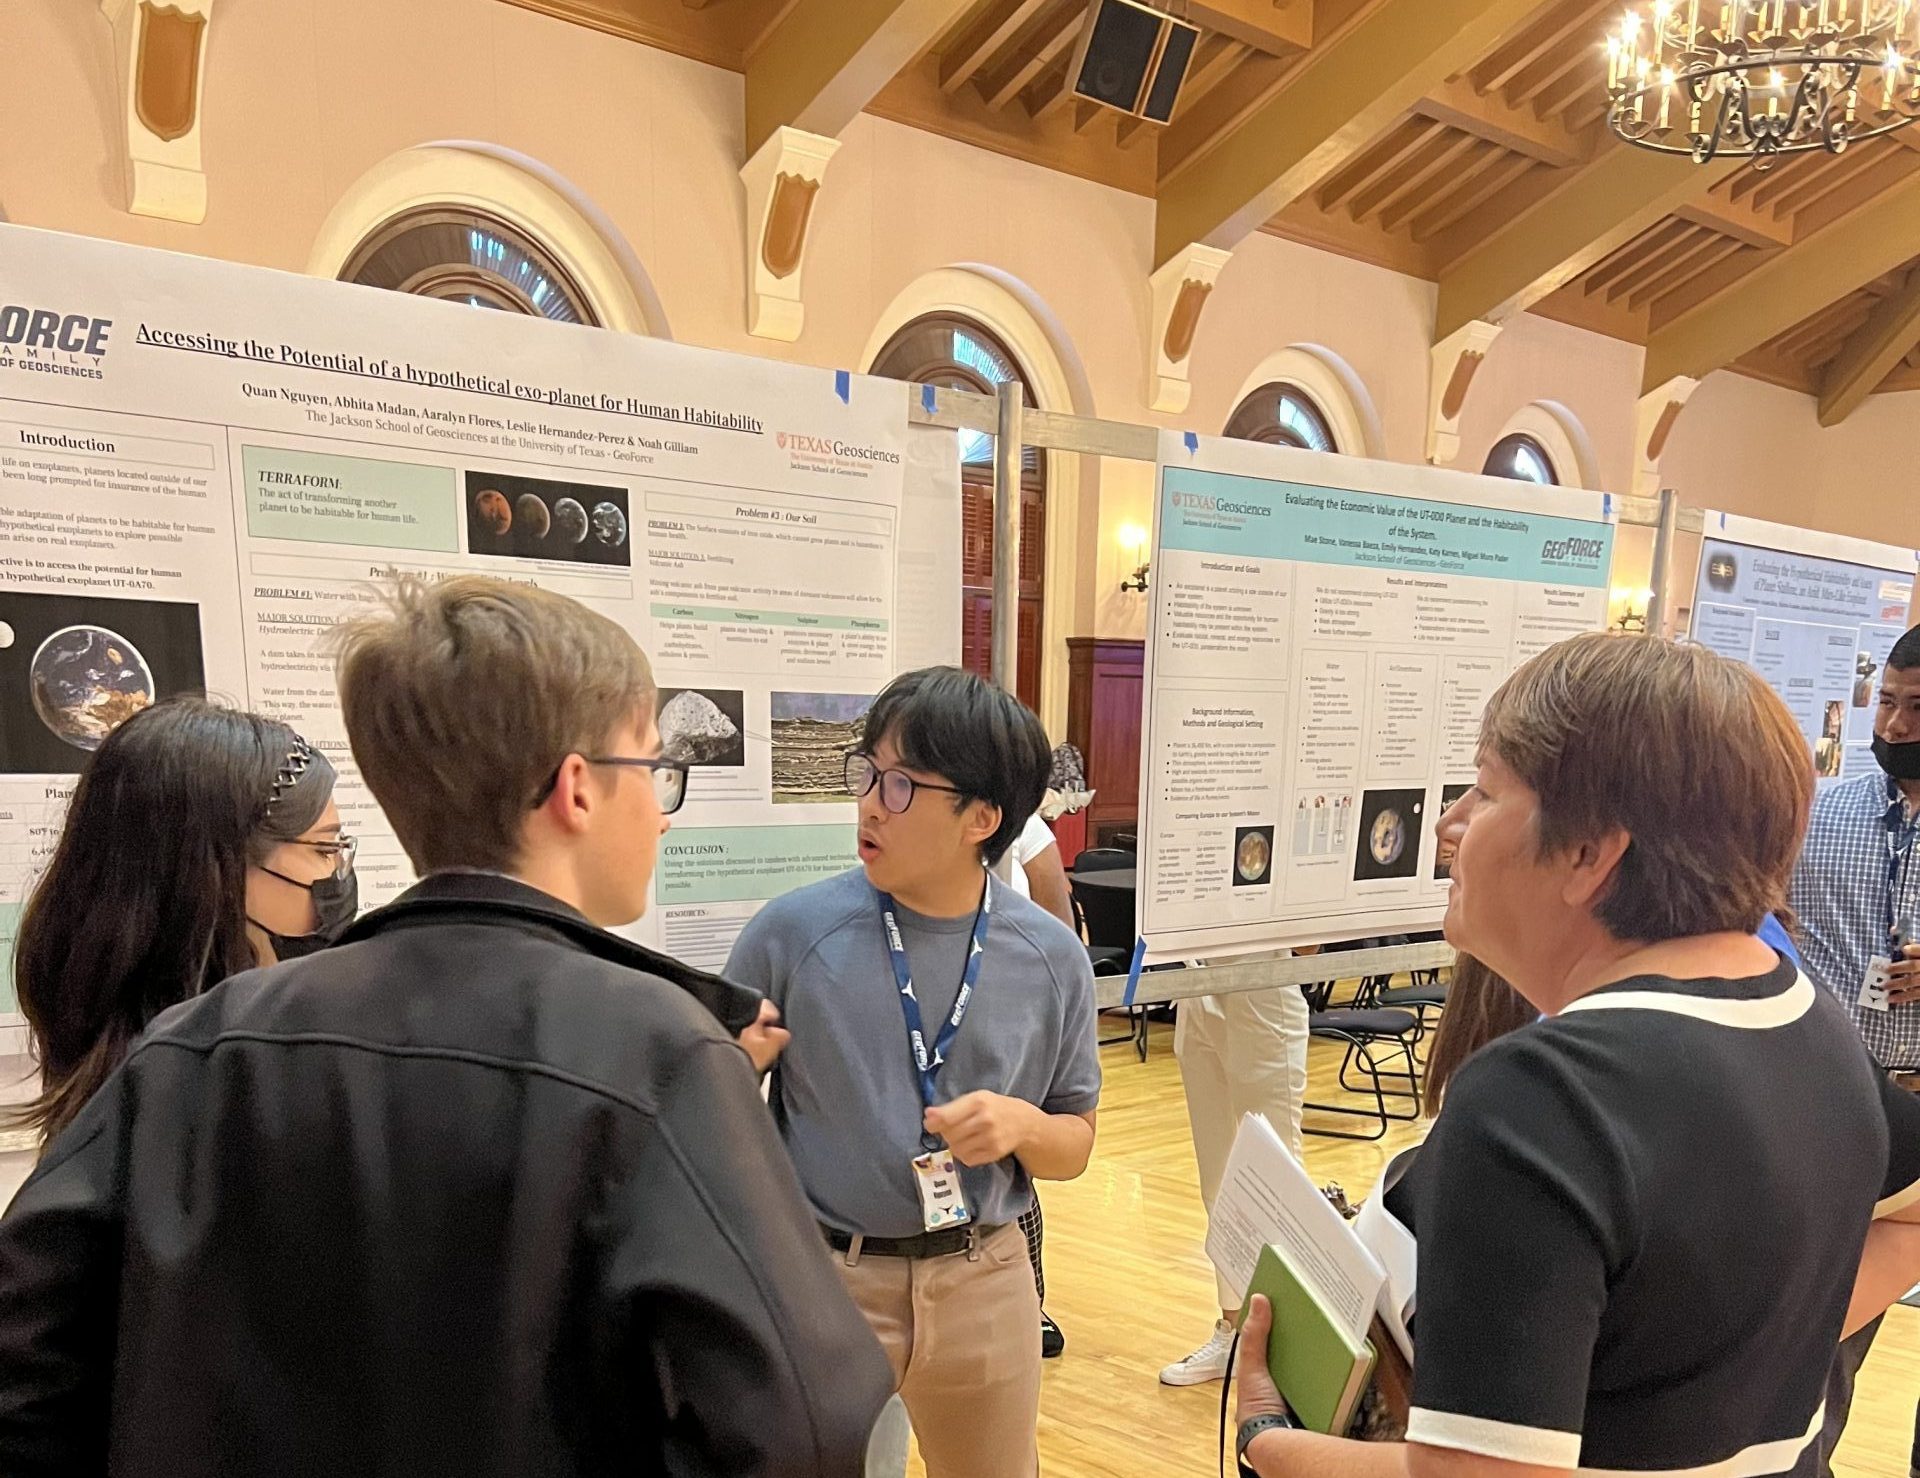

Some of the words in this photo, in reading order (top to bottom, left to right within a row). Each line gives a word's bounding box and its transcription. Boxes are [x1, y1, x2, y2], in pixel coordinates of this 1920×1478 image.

[19, 360, 103, 380] GEOSCIENCES
[136, 323, 239, 357] Accessing
[244, 340, 275, 360] the
[280, 344, 364, 374] Potential
[369, 359, 389, 377] of
[392, 365, 402, 379] a
[406, 363, 510, 395] hypothetical
[515, 384, 597, 408] exo-planet
[601, 394, 623, 412] for
[627, 398, 680, 420] Human
[684, 406, 764, 434] Habitability
[242, 383, 277, 399] Quan
[281, 387, 332, 407] Nguyen,
[334, 395, 374, 412] Abhita
[377, 401, 420, 419] Madan,
[421, 408, 466, 425] Aaralyn
[469, 414, 505, 430] Flores,
[507, 419, 537, 434] Leslie
[539, 424, 625, 446] Hernandez-Perez
[627, 436, 635, 446] &
[638, 436, 662, 450] Noah
[664, 440, 699, 455] Gilliam
[20, 430, 116, 453] Introduction
[305, 409, 327, 423] The
[329, 412, 373, 429] Jackson
[376, 418, 411, 433] School
[413, 422, 424, 435] of
[426, 425, 488, 443] Geosciences
[490, 434, 500, 445] at
[501, 435, 517, 447] the
[519, 437, 564, 455] University
[567, 444, 577, 455] of
[579, 445, 605, 458] Texas
[788, 434, 832, 454] TEXAS
[833, 440, 900, 464] Geosciences
[2, 457, 17, 467] life
[19, 460, 31, 469] on
[84, 466, 115, 478] planets
[117, 469, 149, 481] located
[150, 472, 181, 484] outside
[183, 476, 192, 485] of
[258, 470, 343, 489] TERRAFORM:
[3, 470, 25, 480] been
[27, 471, 47, 484] long
[50, 475, 92, 488] prompted
[94, 477, 106, 488] for
[152, 483, 161, 494] of
[163, 485, 176, 495] the
[258, 487, 276, 498] The
[278, 489, 292, 499] act
[293, 490, 304, 500] of
[305, 491, 362, 507] transforming
[364, 499, 397, 509] another
[1182, 492, 1216, 510] TEXAS
[1216, 497, 1272, 516] Geosciences
[1285, 493, 1324, 510] Evaluating
[1326, 499, 1339, 509] the
[259, 502, 288, 513] planet
[289, 504, 299, 514] to
[301, 504, 313, 515] be
[314, 506, 355, 519] habitable
[357, 510, 370, 520] for
[736, 507, 769, 519] Problem
[786, 512, 800, 522] Our
[802, 514, 817, 524] Soil
[66, 512, 75, 521] of
[76, 514, 107, 526] planets
[109, 517, 118, 526] to
[119, 517, 130, 527] be
[172, 521, 185, 531] for
[12, 534, 35, 543] arise
[37, 536, 48, 544] on
[51, 536, 67, 545] real
[104, 527, 114, 537] to
[25, 558, 34, 568] is
[35, 560, 45, 568] to
[47, 561, 77, 571] access
[78, 562, 93, 572] the
[94, 563, 134, 575] potential
[136, 566, 149, 576] for
[6, 571, 65, 584] hypothetical
[67, 577, 112, 588] exoplanet
[254, 587, 299, 599] PROBLEM
[257, 612, 287, 622] MAJOR
[259, 625, 315, 637] Hydroelectric
